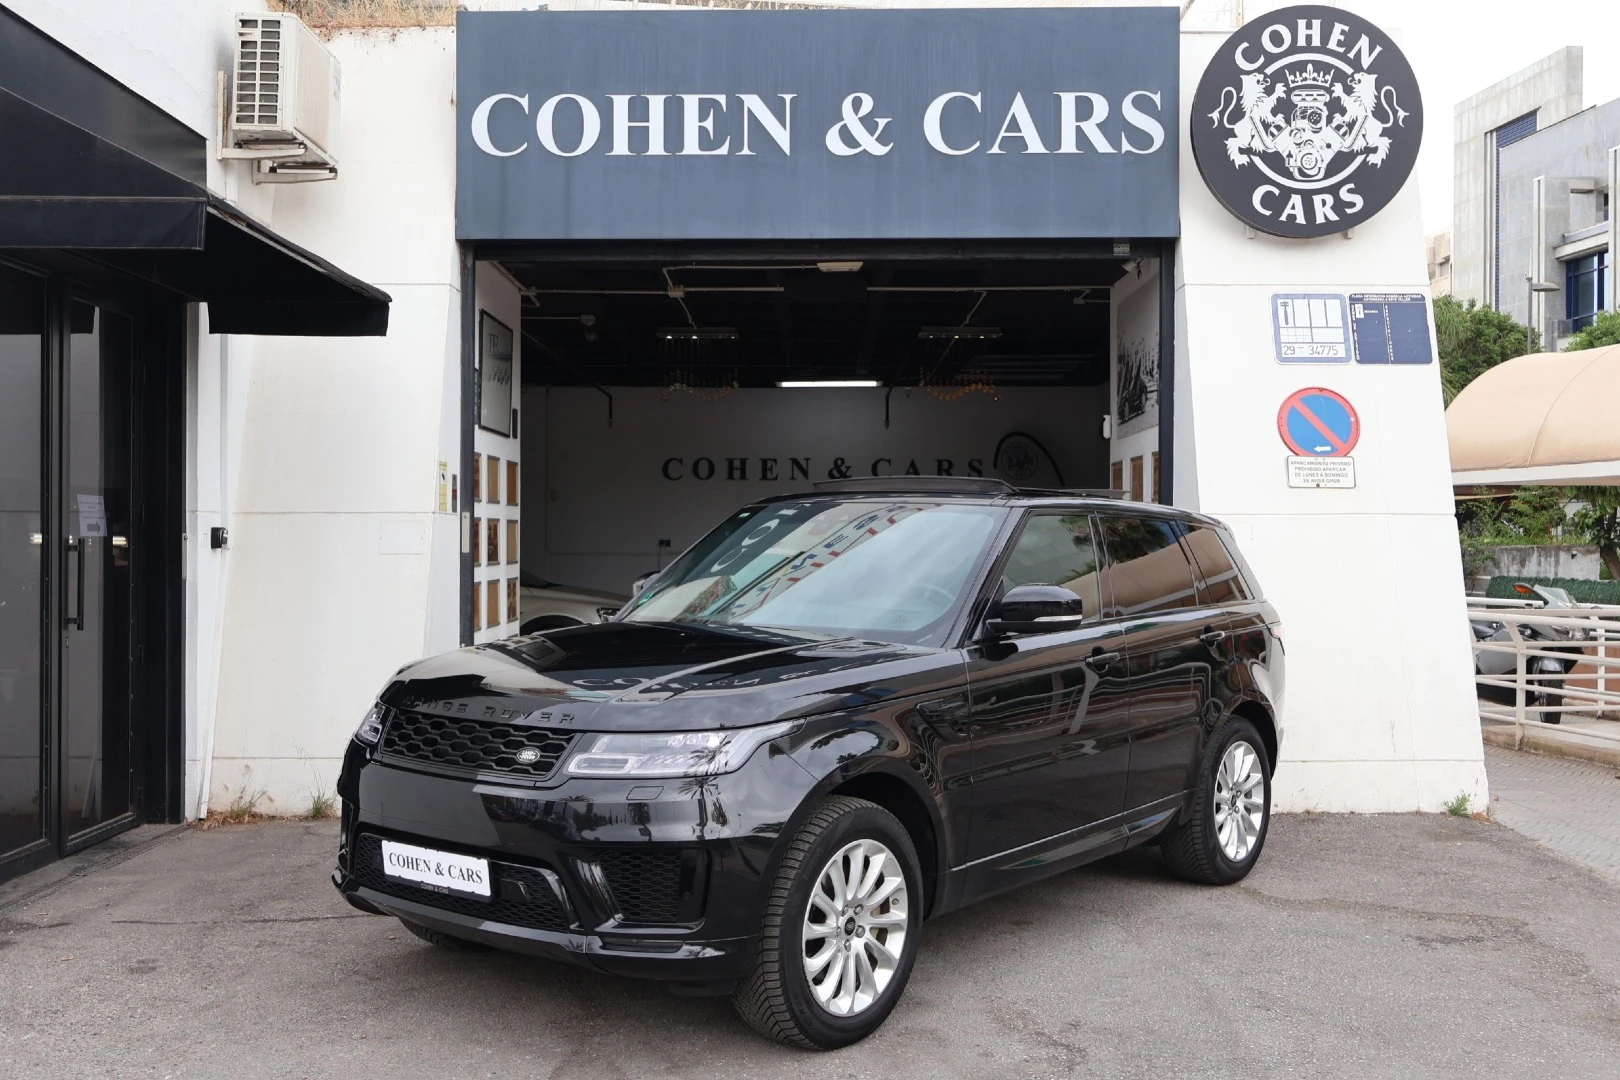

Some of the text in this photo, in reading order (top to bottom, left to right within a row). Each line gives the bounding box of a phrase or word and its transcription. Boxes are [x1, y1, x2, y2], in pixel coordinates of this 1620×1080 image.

[1234, 19, 1383, 71] COHEN
[471, 91, 1166, 157] COHEN & CARS
[1252, 183, 1364, 225] CARS
[1283, 345, 1296, 356] 29
[1308, 345, 1339, 356] 34775
[661, 457, 811, 482] COHEN
[827, 457, 852, 480] &
[871, 458, 984, 478] CARS
[483, 706, 575, 725] ROVER
[389, 852, 483, 884] COHEN & CARS
